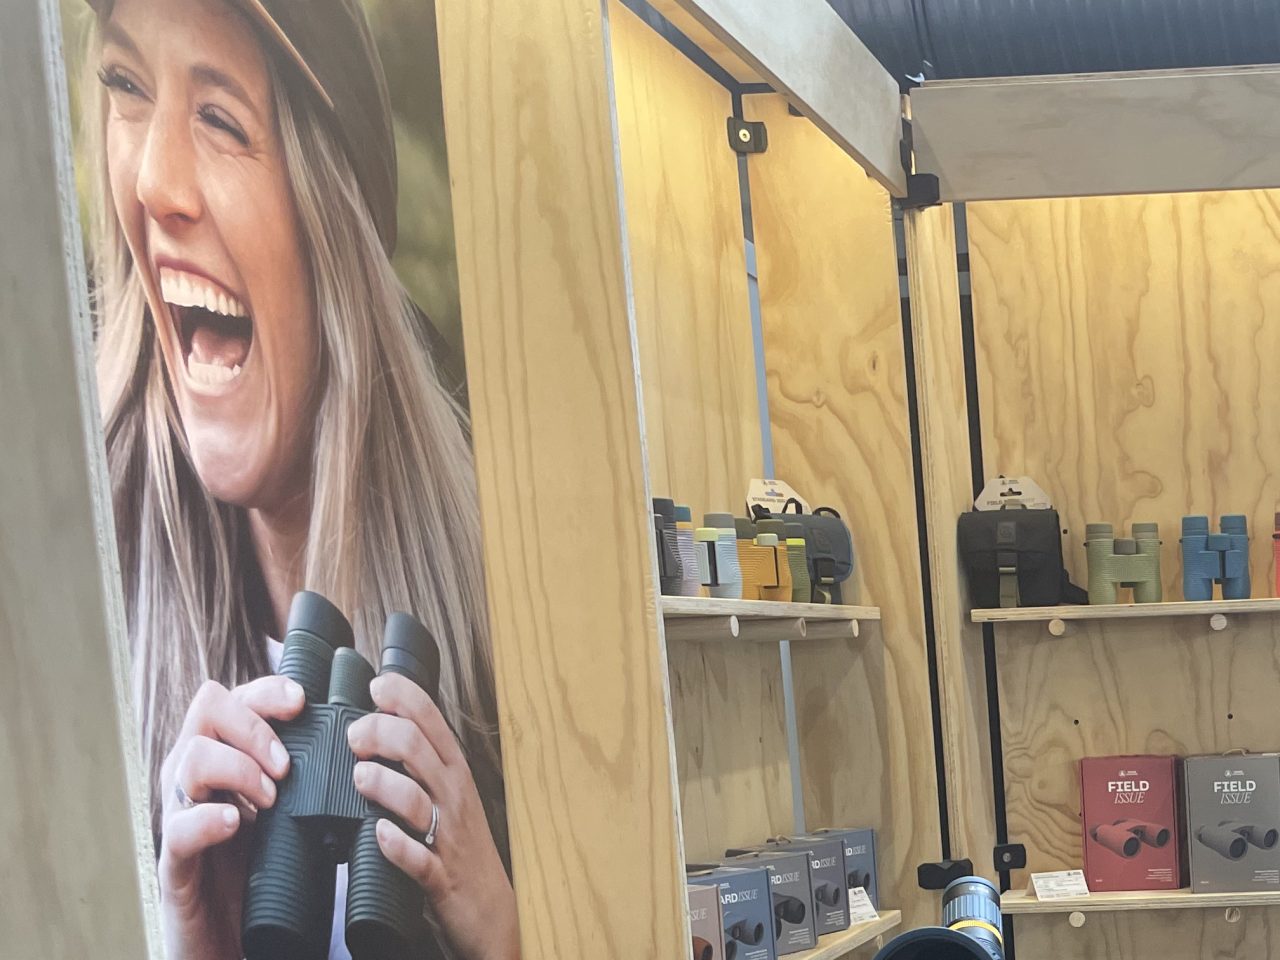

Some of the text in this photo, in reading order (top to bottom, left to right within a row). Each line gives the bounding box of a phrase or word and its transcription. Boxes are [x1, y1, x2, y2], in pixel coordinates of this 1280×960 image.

[1108, 780, 1149, 792] FIELD
[1214, 780, 1256, 792] FIELD
[1114, 792, 1145, 804] ISSUE
[1220, 792, 1252, 804] ISSUE
[819, 857, 836, 868] ISSUE
[782, 872, 800, 883] ISSUE
[737, 889, 758, 900] ISSUE
